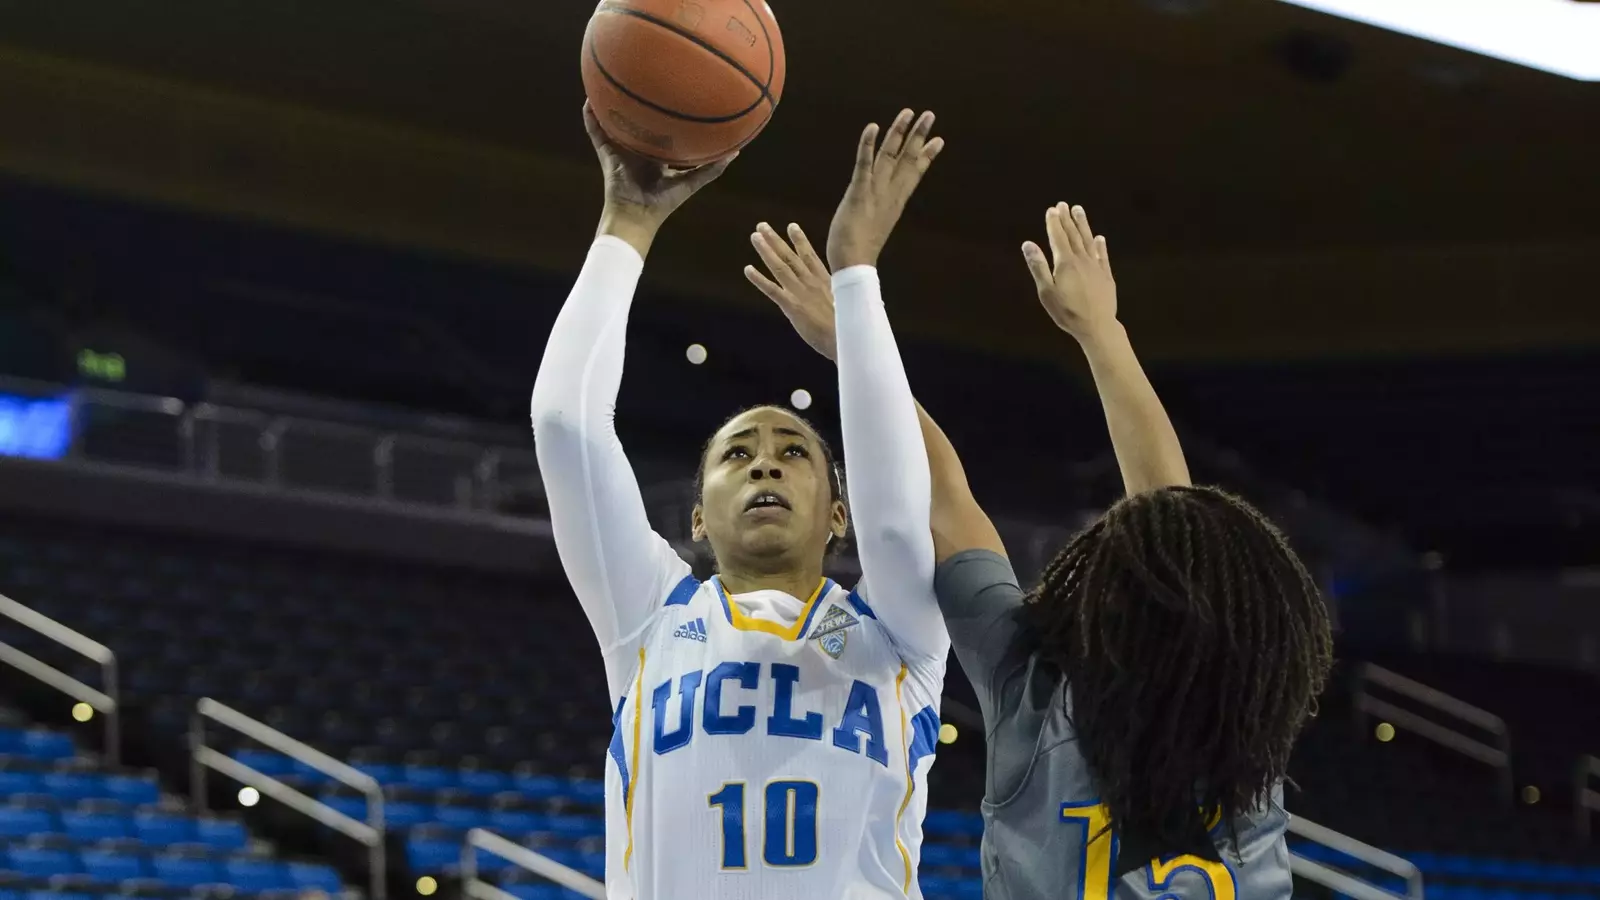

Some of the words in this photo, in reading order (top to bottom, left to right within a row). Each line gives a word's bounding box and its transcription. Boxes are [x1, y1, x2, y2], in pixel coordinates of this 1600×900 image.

[673, 628, 708, 643] adidas
[651, 661, 889, 768] UCLA
[707, 779, 819, 870] 10
